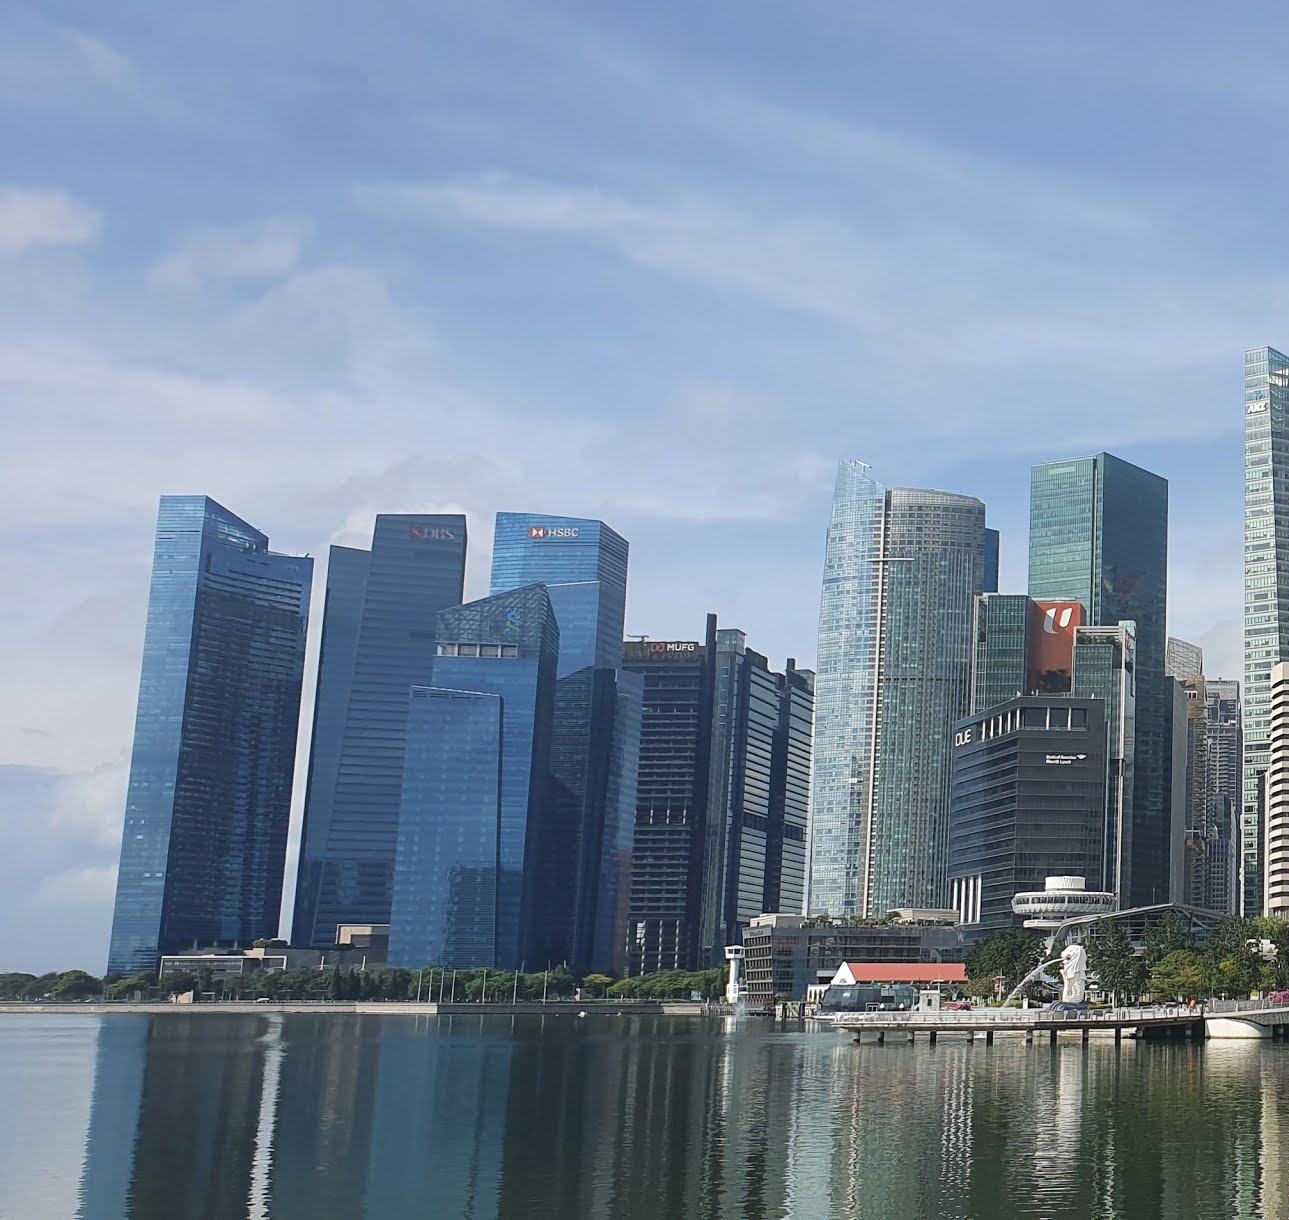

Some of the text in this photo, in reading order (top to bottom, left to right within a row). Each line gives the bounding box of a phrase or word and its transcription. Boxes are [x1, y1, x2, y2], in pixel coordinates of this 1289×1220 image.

[1247, 402, 1267, 413] ANZ
[423, 528, 455, 541] DBS
[548, 527, 579, 538] HSBC
[666, 643, 695, 651] MUFG
